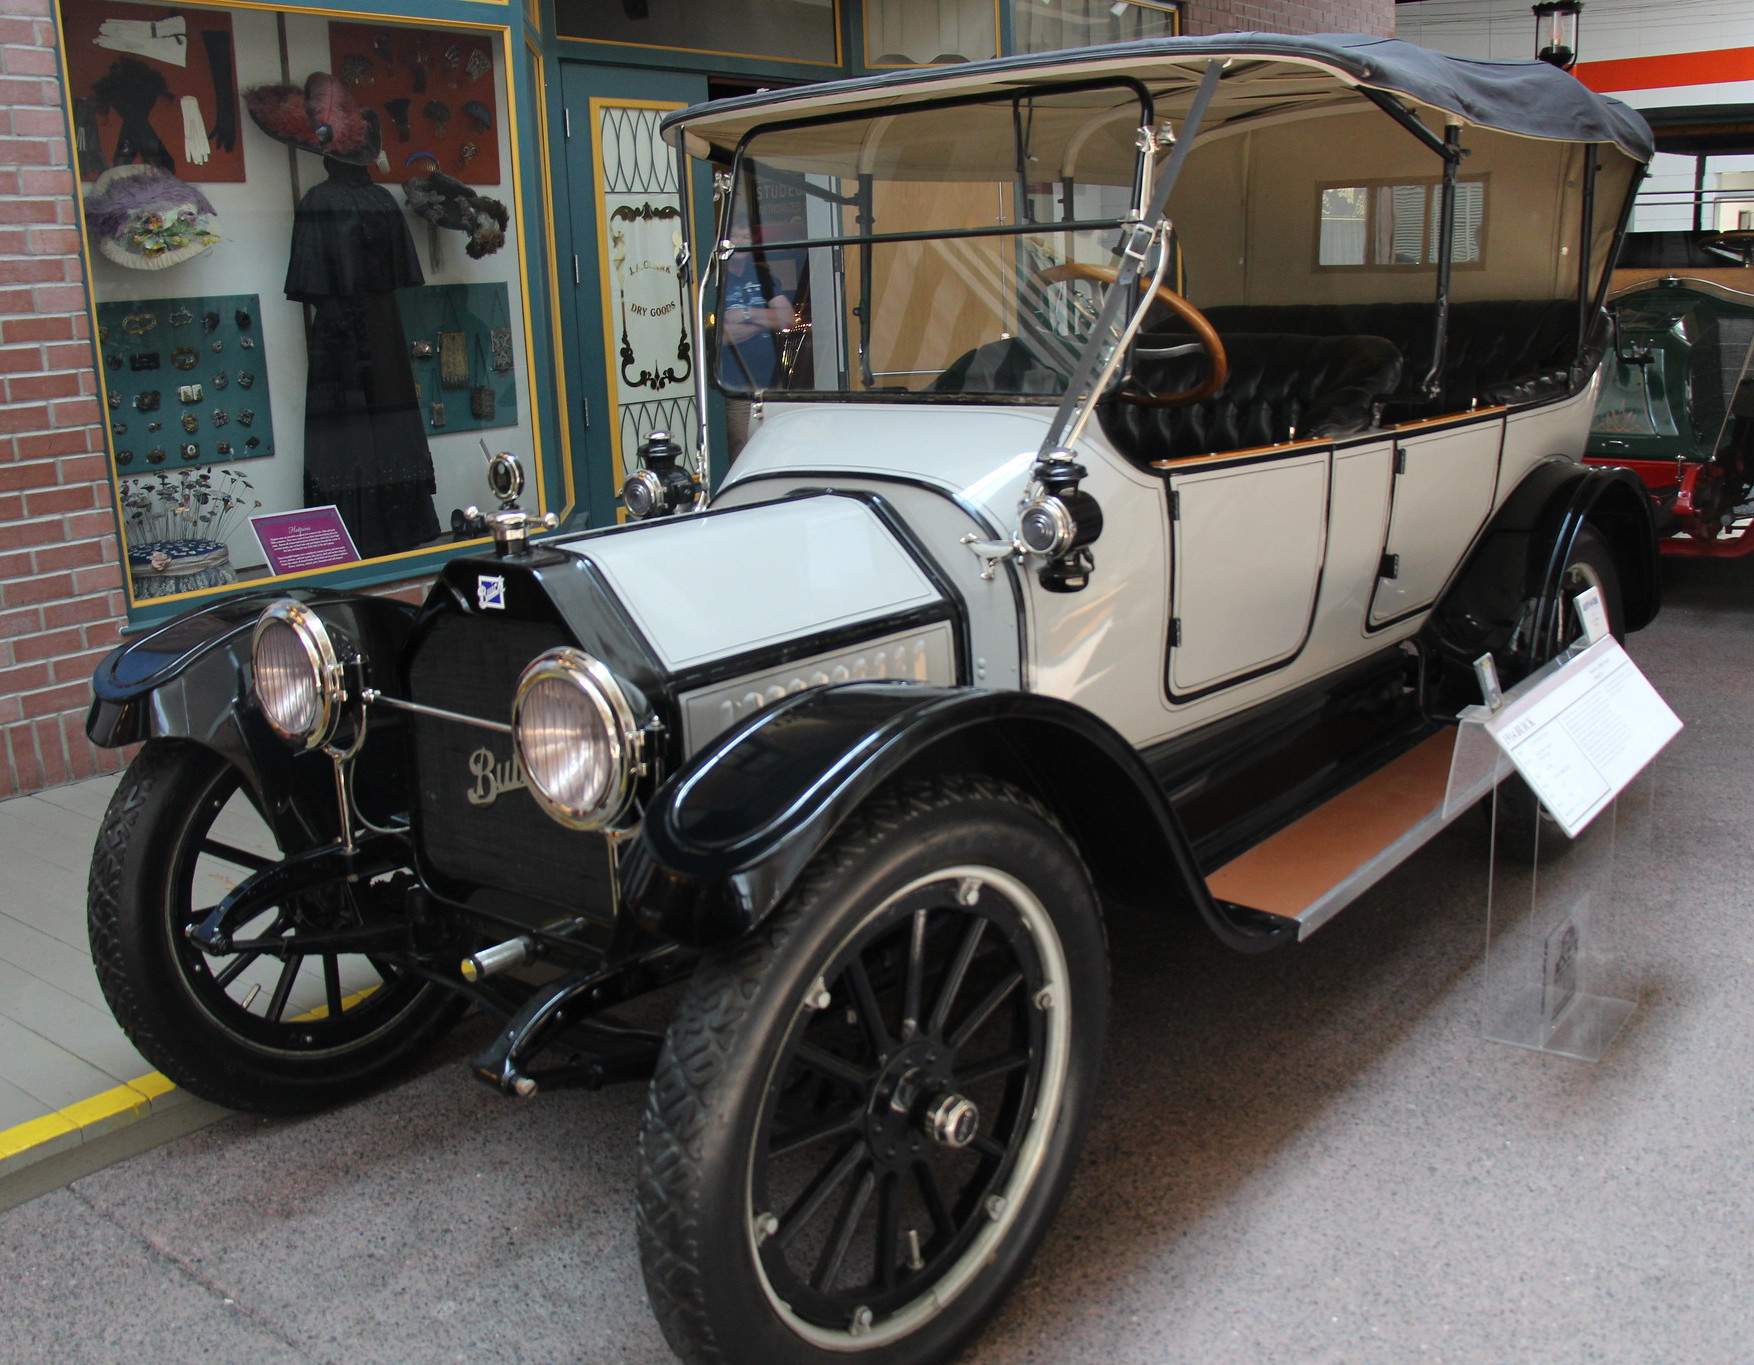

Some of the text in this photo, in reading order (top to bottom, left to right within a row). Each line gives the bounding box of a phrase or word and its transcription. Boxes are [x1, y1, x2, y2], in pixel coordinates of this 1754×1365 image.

[630, 300, 676, 317] DRY GOODS
[477, 574, 506, 609] Buick
[467, 746, 528, 804] Bui
